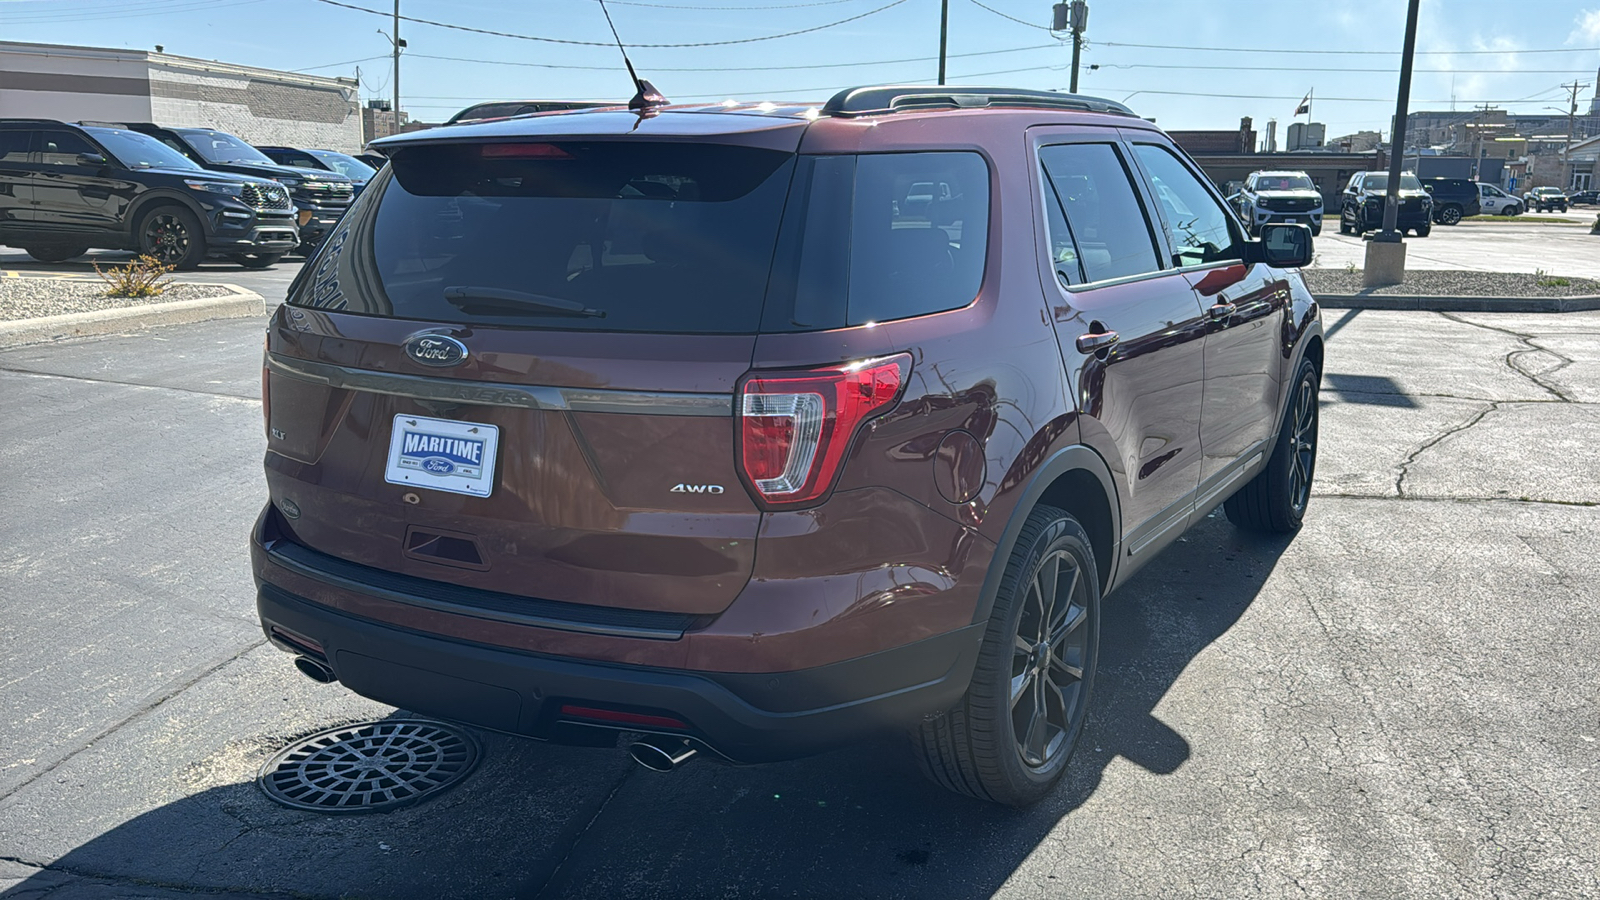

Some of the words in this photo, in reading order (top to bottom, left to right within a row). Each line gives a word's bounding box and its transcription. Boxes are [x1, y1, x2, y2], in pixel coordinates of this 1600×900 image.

[415, 338, 451, 360] Ford
[403, 432, 482, 464] MARITIME
[426, 460, 450, 473] Ford
[669, 483, 725, 495] 4WD
